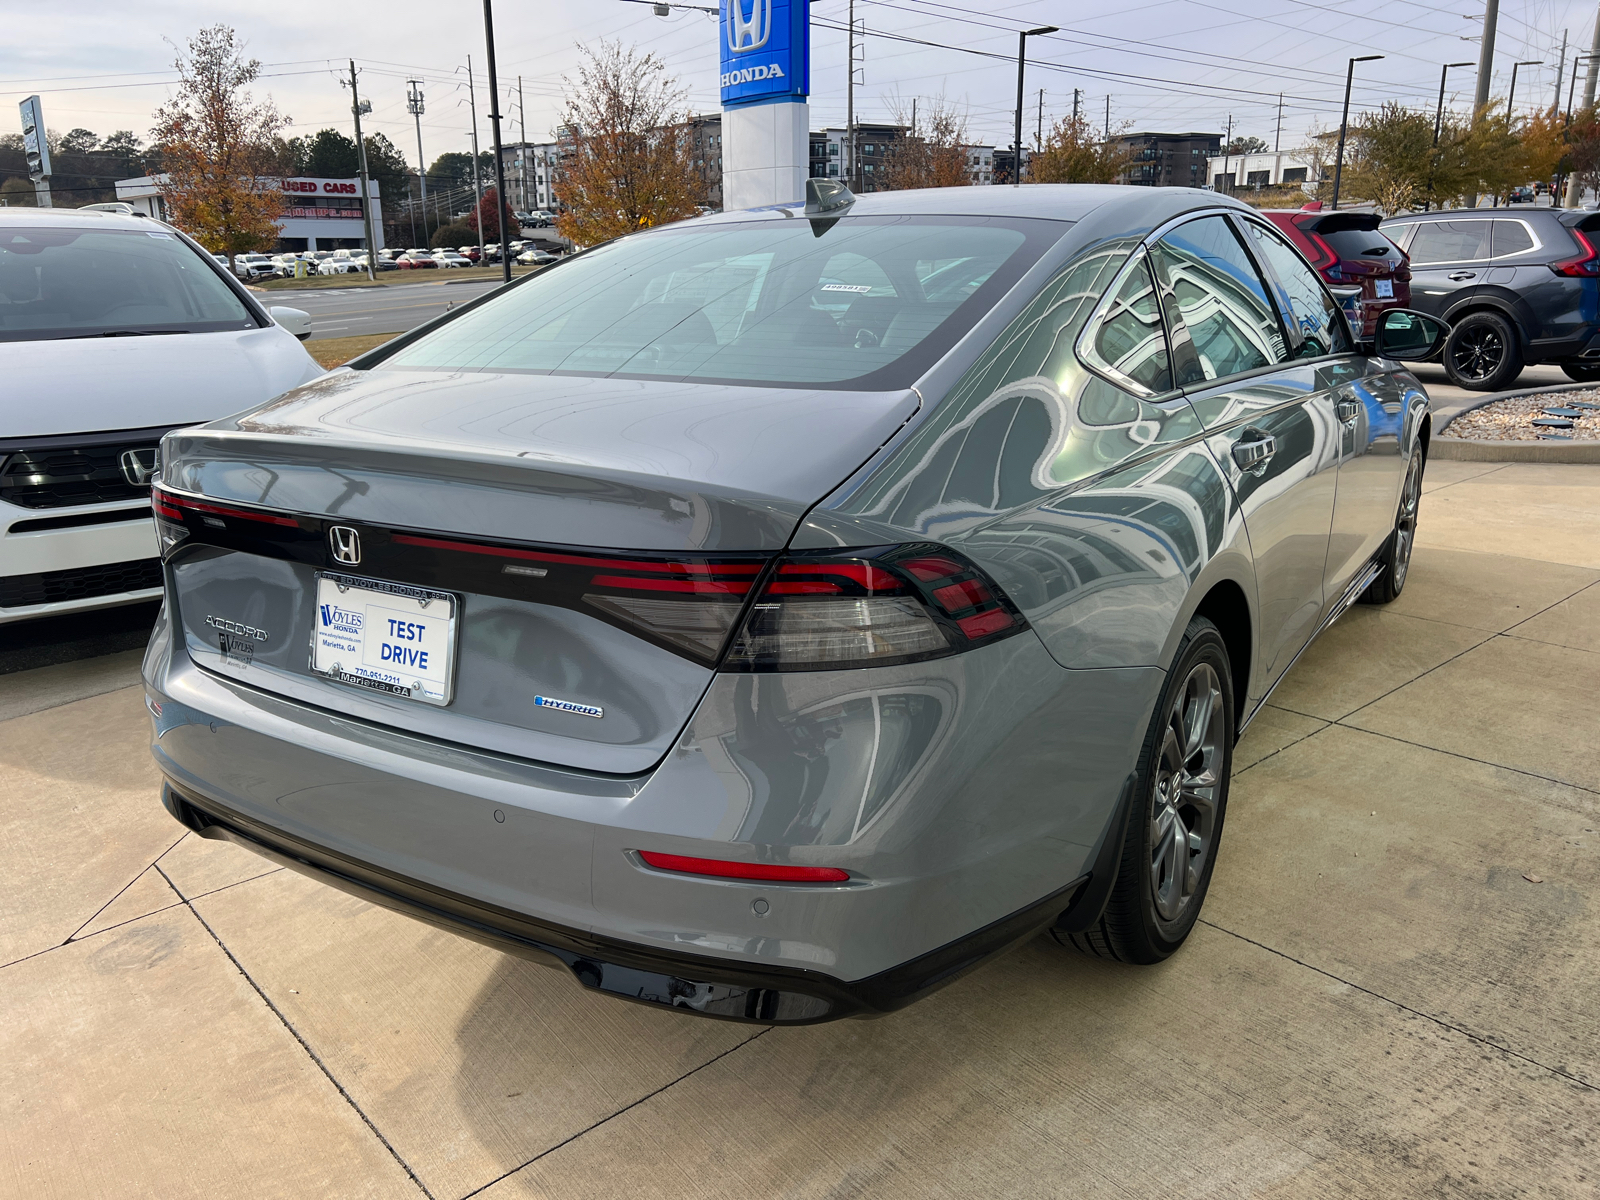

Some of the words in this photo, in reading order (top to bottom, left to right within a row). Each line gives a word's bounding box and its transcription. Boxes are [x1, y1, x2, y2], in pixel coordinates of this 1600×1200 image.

[720, 63, 785, 88] HONDA
[281, 180, 317, 193] USED
[323, 182, 357, 194] CARS
[203, 614, 270, 642] ACCORD
[333, 624, 359, 635] HONDA
[387, 618, 426, 643] TEST
[322, 639, 346, 651] Marietta,
[346, 644, 356, 653] GA
[381, 642, 429, 670] DRIVE
[340, 672, 389, 692] Marietta,
[392, 685, 410, 696] GA
[542, 698, 600, 716] HYBRID
